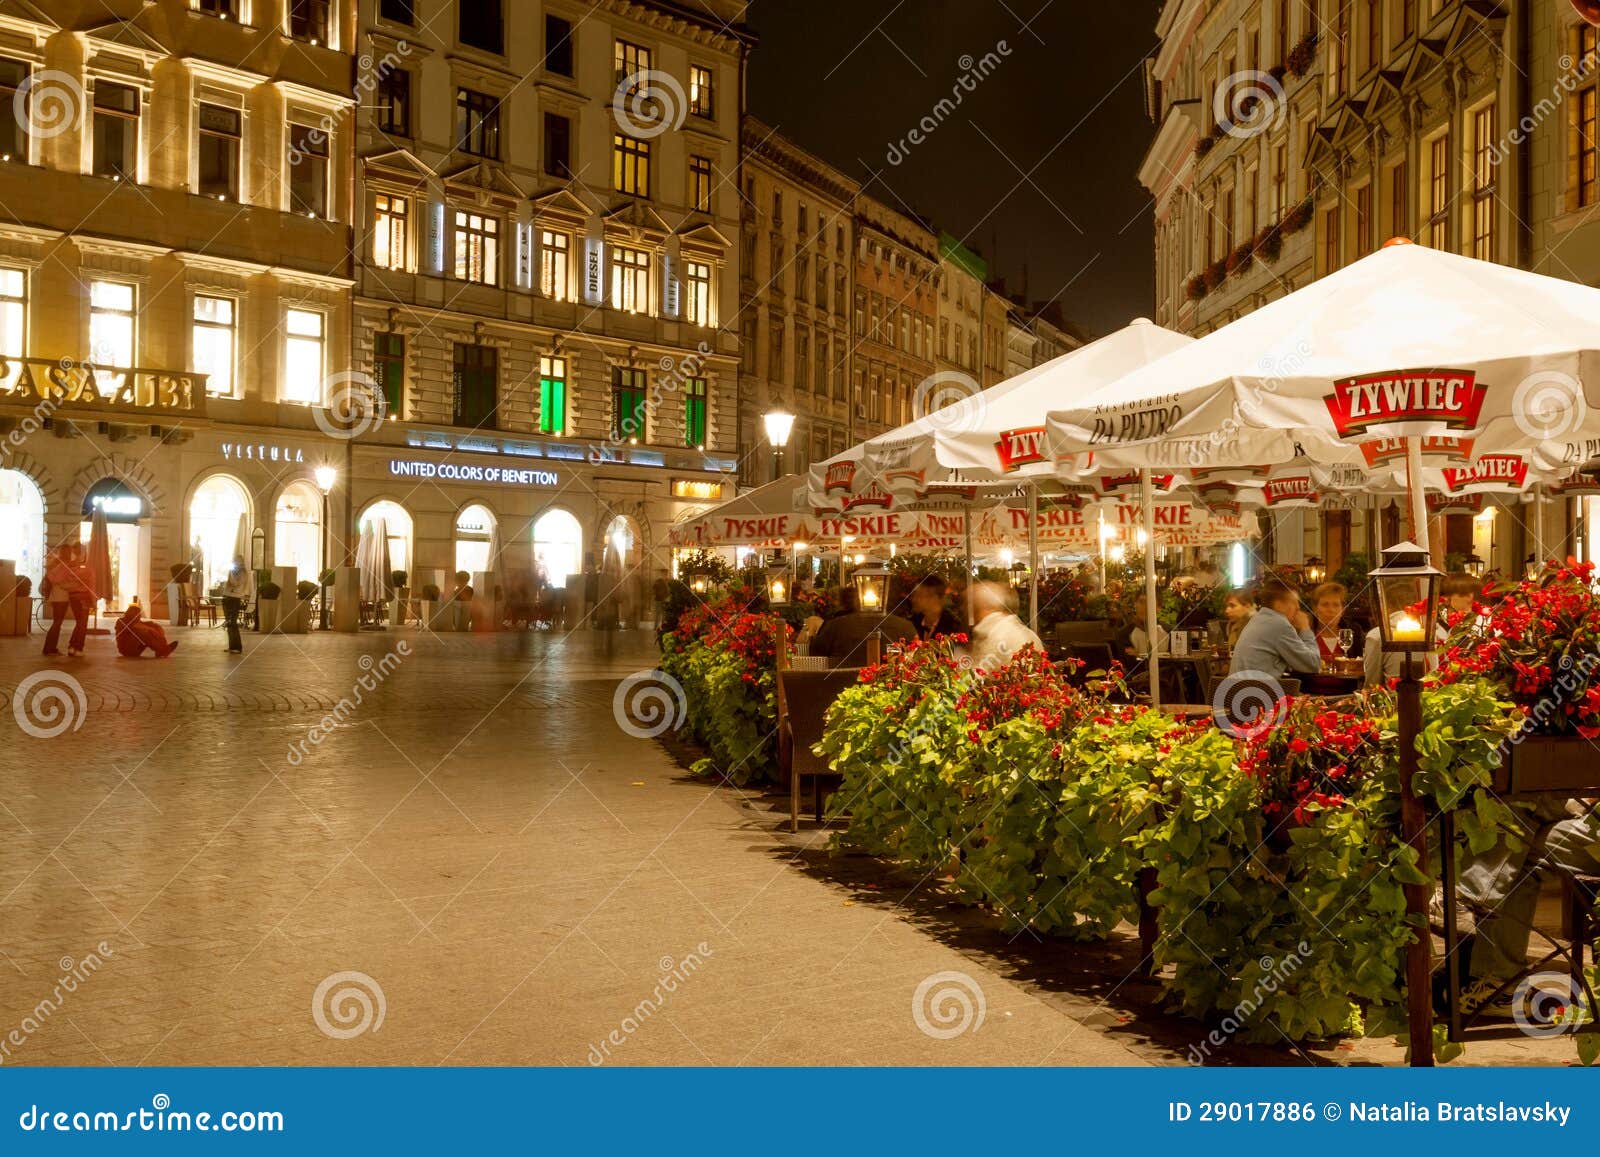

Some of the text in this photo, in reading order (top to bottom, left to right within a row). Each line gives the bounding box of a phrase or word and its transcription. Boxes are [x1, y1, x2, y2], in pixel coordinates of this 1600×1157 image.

[589, 248, 599, 293] DIESEL
[1345, 378, 1465, 418] ŻYWIEC
[1088, 405, 1183, 445] DA PIETRO
[222, 443, 304, 462] VISTULA
[391, 461, 558, 485] UNITED COLORS OF BENETTON
[724, 515, 789, 539] TYSKIE
[821, 514, 901, 536] TYSKIE
[926, 513, 963, 536] TYSKI
[1115, 504, 1192, 526] TYKIE
